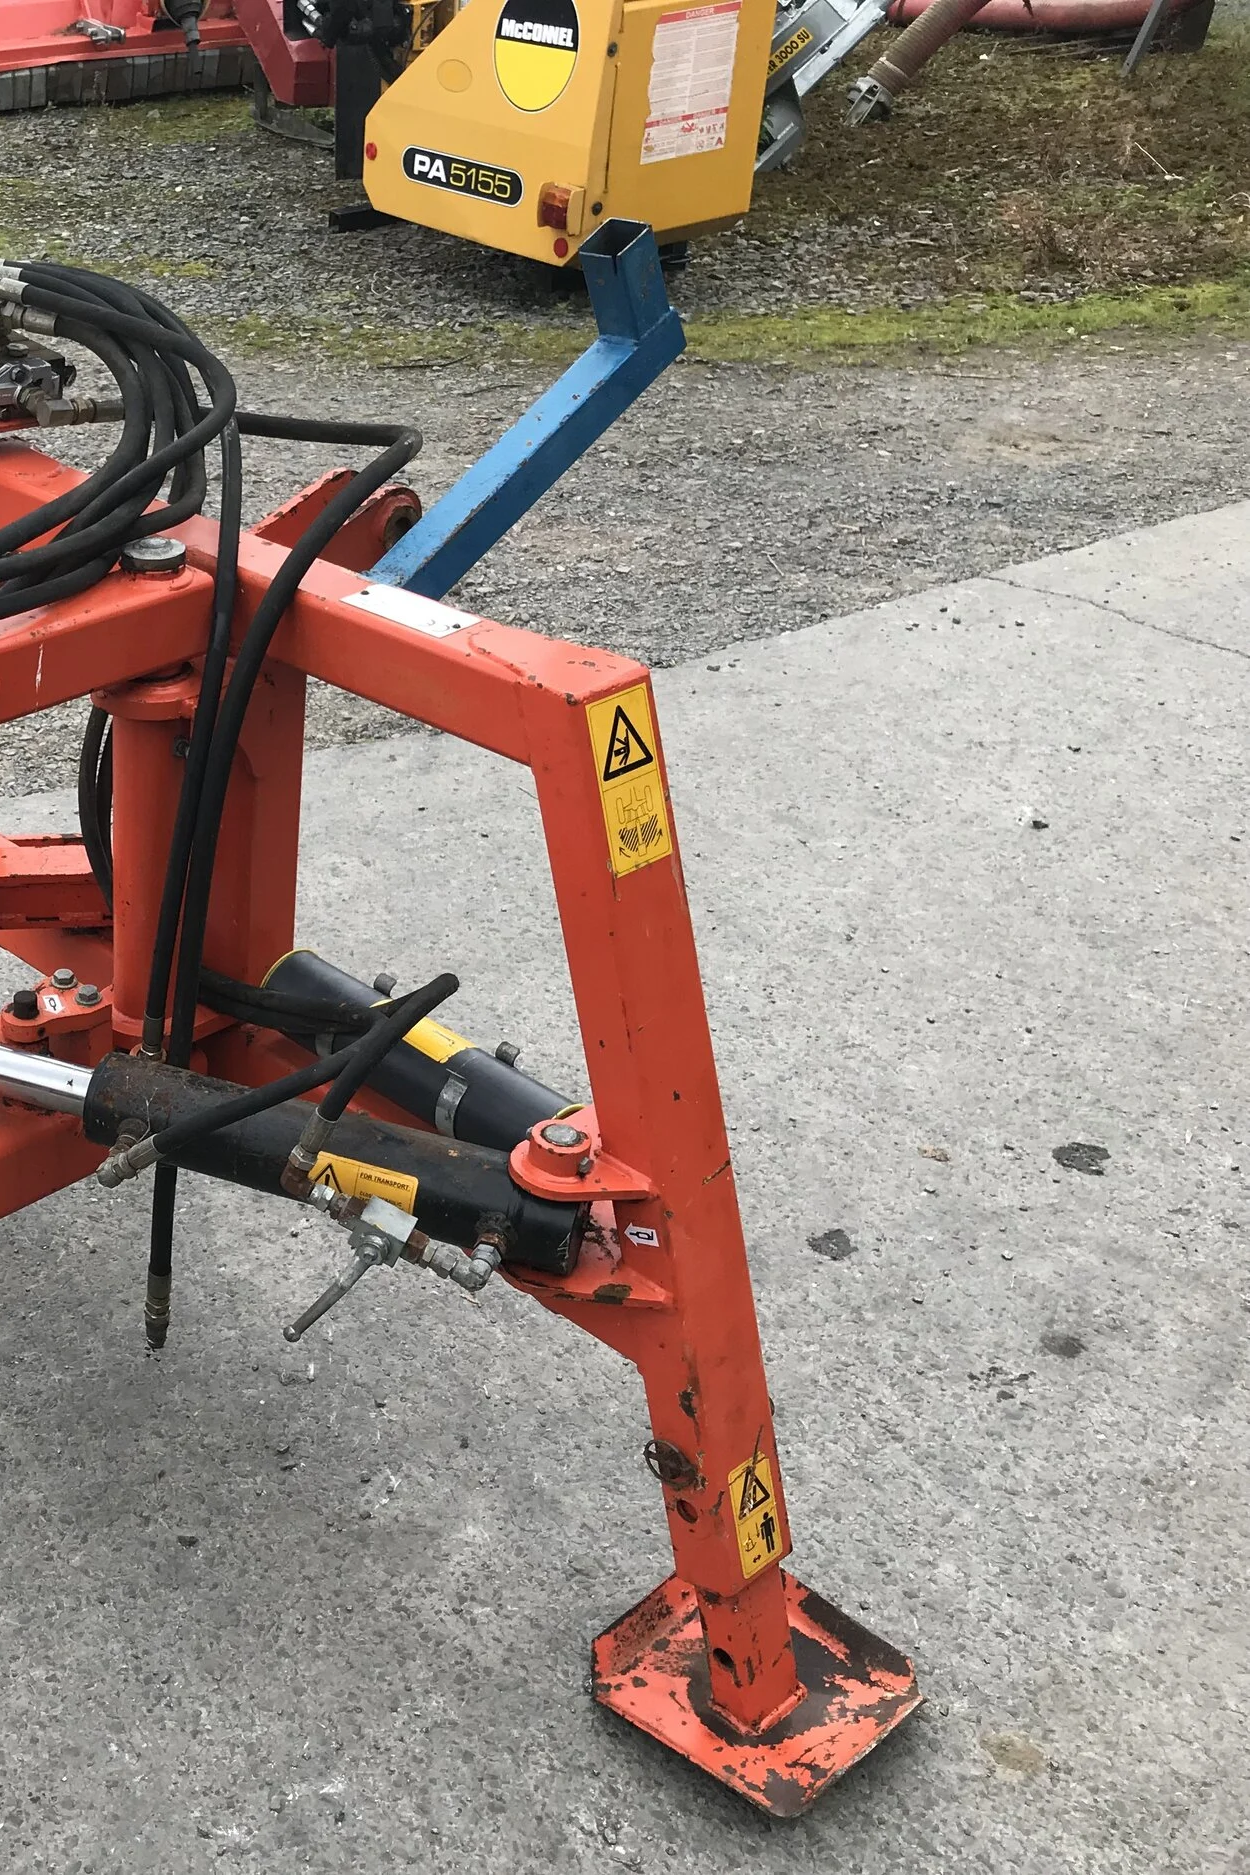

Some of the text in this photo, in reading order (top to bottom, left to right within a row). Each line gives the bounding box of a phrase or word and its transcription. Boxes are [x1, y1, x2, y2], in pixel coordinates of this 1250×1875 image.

[685, 7, 715, 19] DANGER
[500, 17, 575, 48] McCONNEL
[775, 40, 799, 63] 3000
[797, 29, 810, 43] SU
[359, 1172, 373, 1181] FOR
